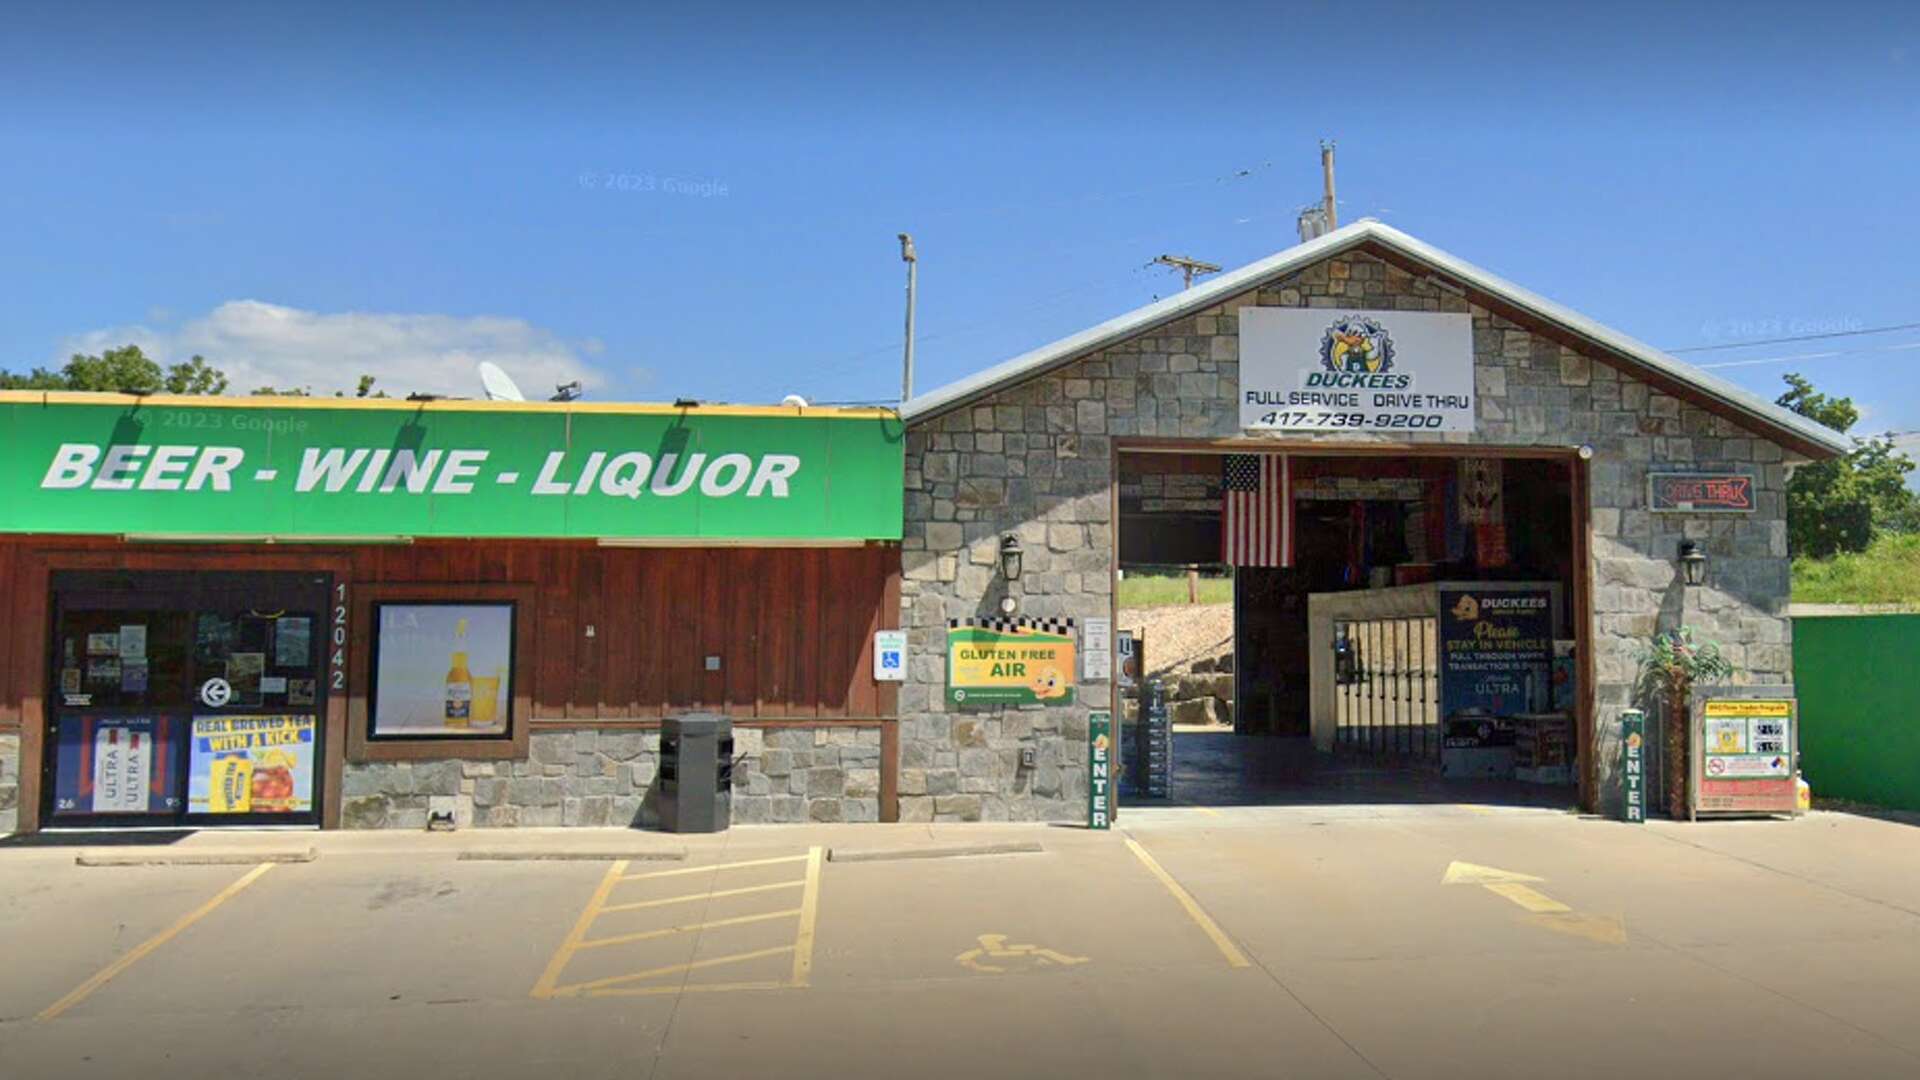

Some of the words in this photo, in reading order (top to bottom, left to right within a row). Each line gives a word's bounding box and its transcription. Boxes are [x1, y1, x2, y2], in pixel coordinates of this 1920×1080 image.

[1306, 372, 1411, 389] DUCKEES
[1246, 391, 1286, 406] FULL
[1288, 392, 1360, 407] SERVICE
[1373, 393, 1422, 408] DRIVE
[1426, 394, 1469, 409] THRU
[1260, 411, 1444, 429] 417-739-9200
[40, 443, 245, 492] BEER
[294, 446, 490, 494] WINE
[530, 451, 801, 500] LIQUOR
[1481, 598, 1547, 609] DUCKEES
[331, 583, 346, 690] 12042
[960, 649, 1016, 660] GLUTEN
[1020, 649, 1056, 660] FREE
[990, 662, 1026, 677] AIR
[1475, 683, 1521, 695] ULTRA
[197, 719, 226, 733] REAL
[232, 717, 285, 731] BREWED
[289, 714, 312, 727] TEA
[211, 734, 252, 750] WITH
[255, 732, 266, 747] A
[268, 729, 299, 745] KICK
[105, 749, 119, 799] ULTRA
[126, 754, 140, 803] ULTRA
[1626, 747, 1641, 820] ENTER
[1093, 747, 1107, 827] ENTER
